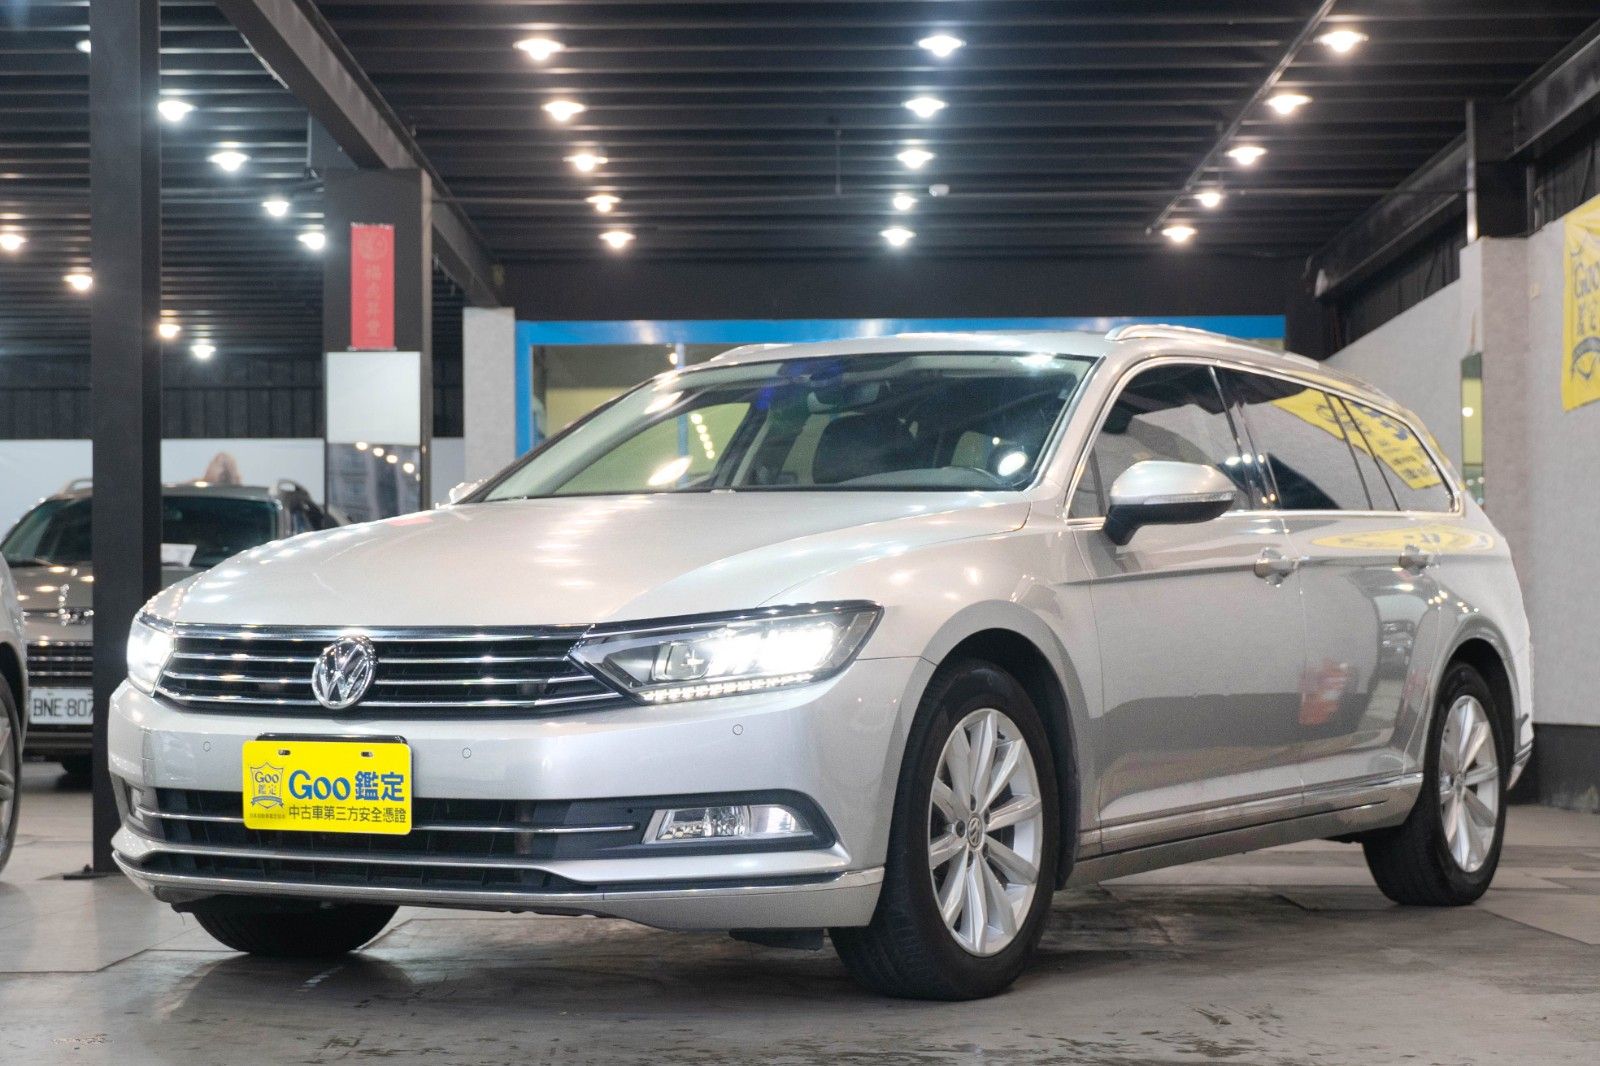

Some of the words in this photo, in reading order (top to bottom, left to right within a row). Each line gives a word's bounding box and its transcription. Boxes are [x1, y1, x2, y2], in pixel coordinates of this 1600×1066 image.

[255, 771, 279, 783] Goo
[289, 769, 351, 800] Goo
[355, 771, 404, 801] 鑑定
[288, 804, 406, 823] 中古車第三方安全憑證
